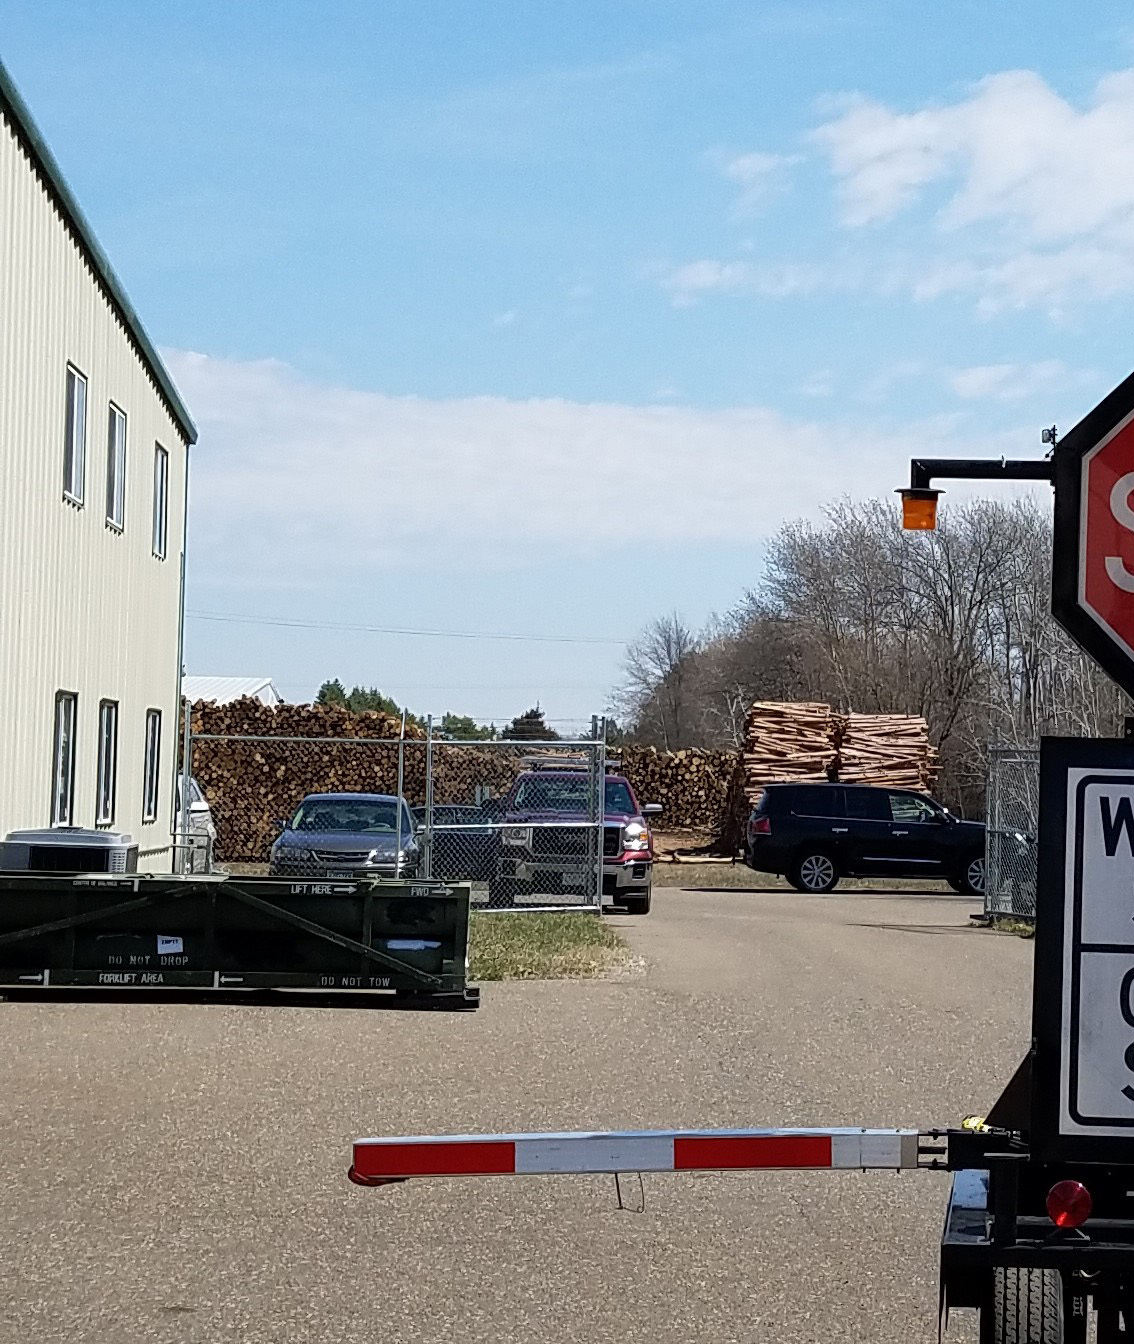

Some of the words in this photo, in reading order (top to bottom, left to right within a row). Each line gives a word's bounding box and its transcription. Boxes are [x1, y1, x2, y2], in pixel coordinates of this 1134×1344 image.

[291, 884, 307, 894] LIFT
[312, 885, 332, 895] HERE
[411, 887, 429, 897] FWD
[108, 955, 122, 965] DO
[129, 955, 151, 965] NOT
[160, 955, 189, 966] DROP
[99, 973, 137, 984] FORKLIFT
[140, 973, 164, 984] AREA
[321, 976, 335, 986] DO
[341, 976, 362, 987] NOT
[368, 977, 391, 987] TOW
